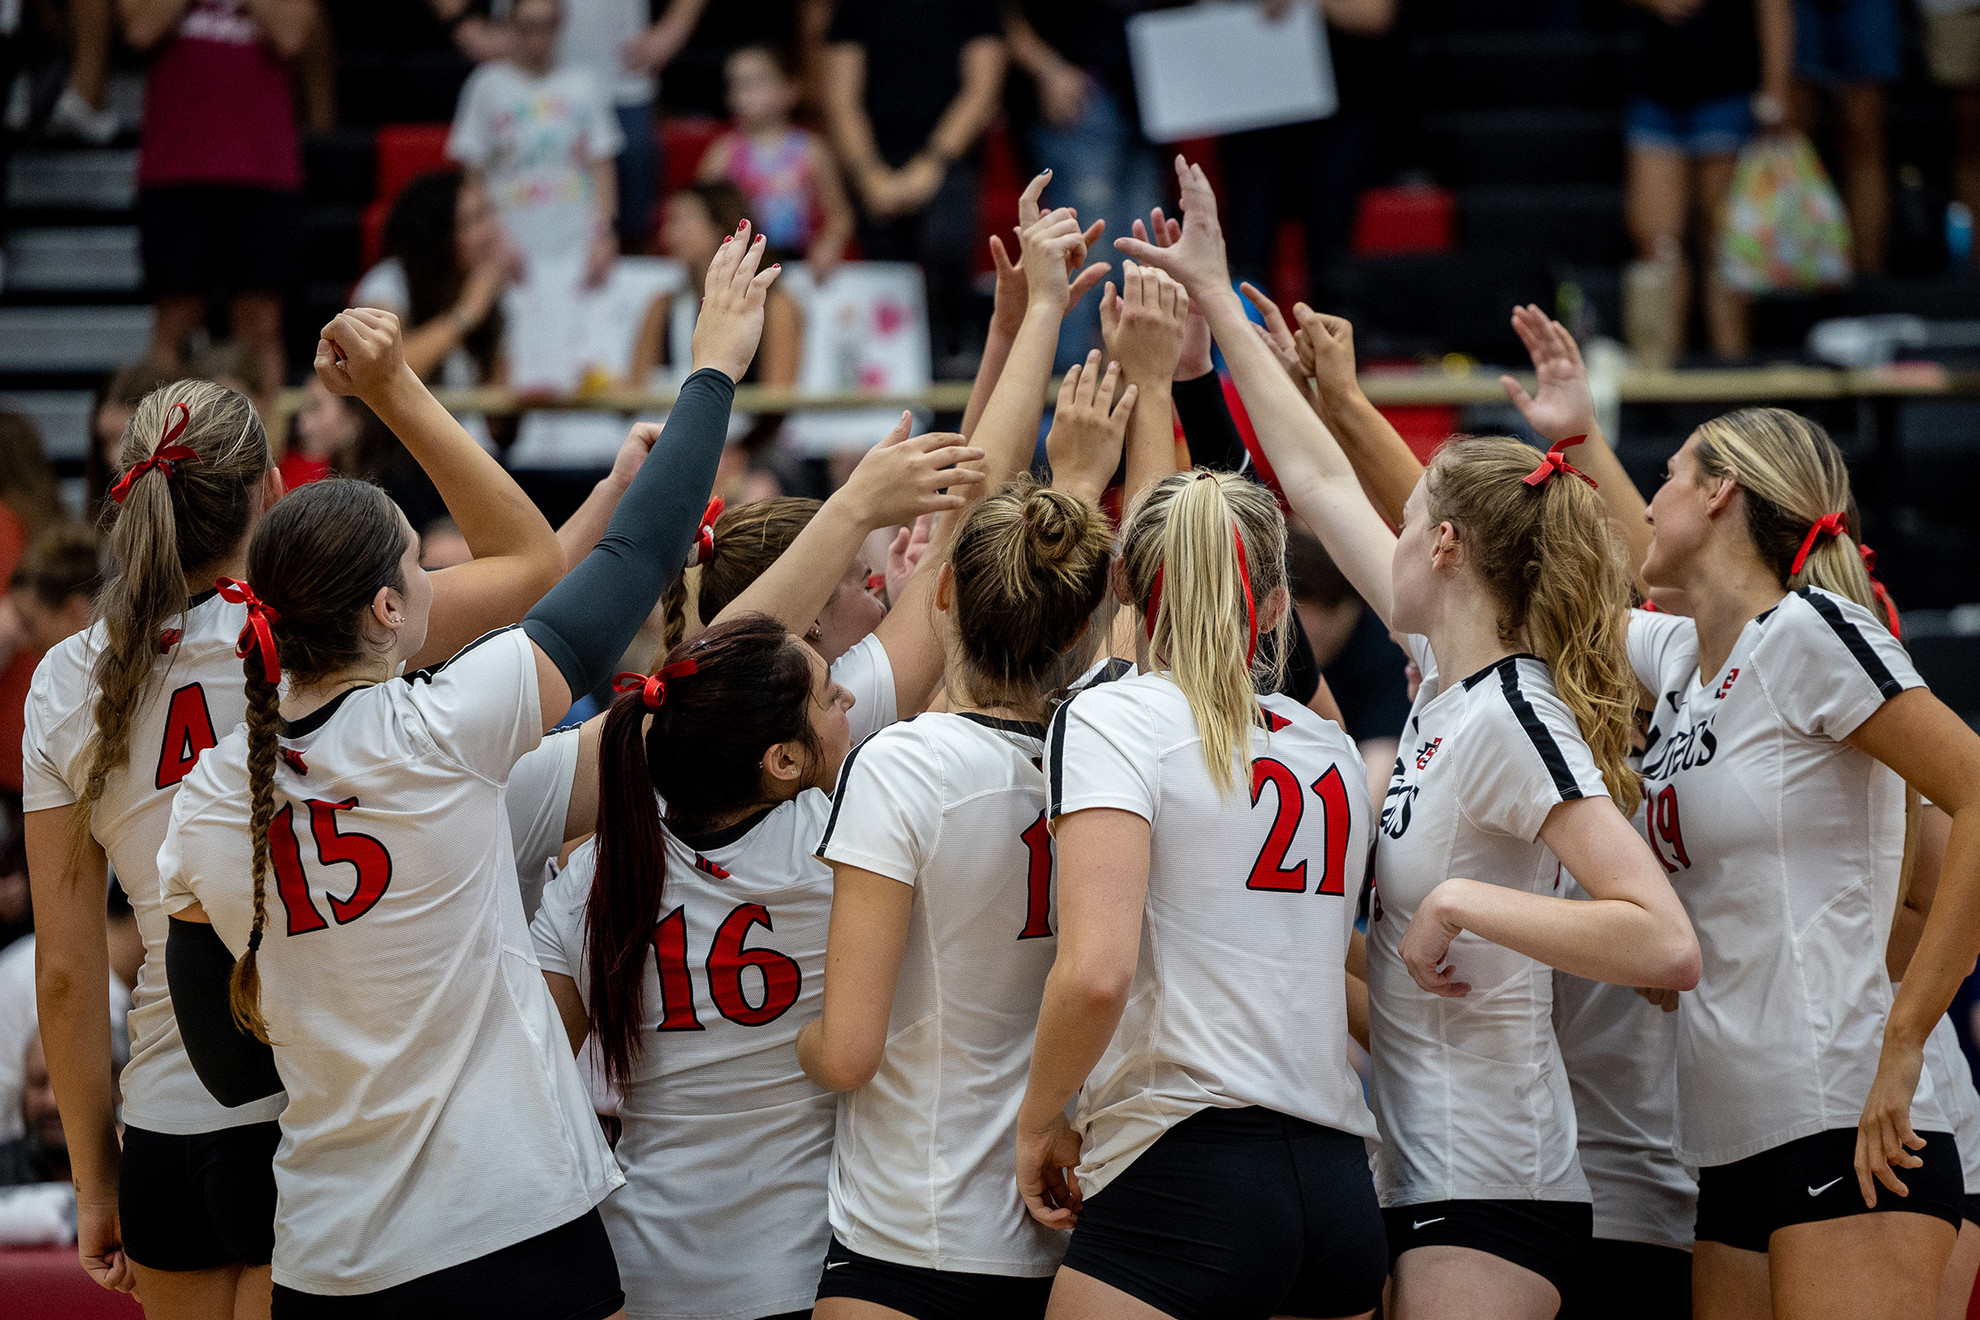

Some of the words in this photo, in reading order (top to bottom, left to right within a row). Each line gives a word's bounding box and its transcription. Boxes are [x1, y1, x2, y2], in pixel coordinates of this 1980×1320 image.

[155, 681, 218, 790] 4
[267, 796, 392, 937] 15
[1016, 807, 1058, 940] 1
[1246, 757, 1352, 897] 21
[1646, 783, 1691, 873] 19
[650, 902, 802, 1032] 16
